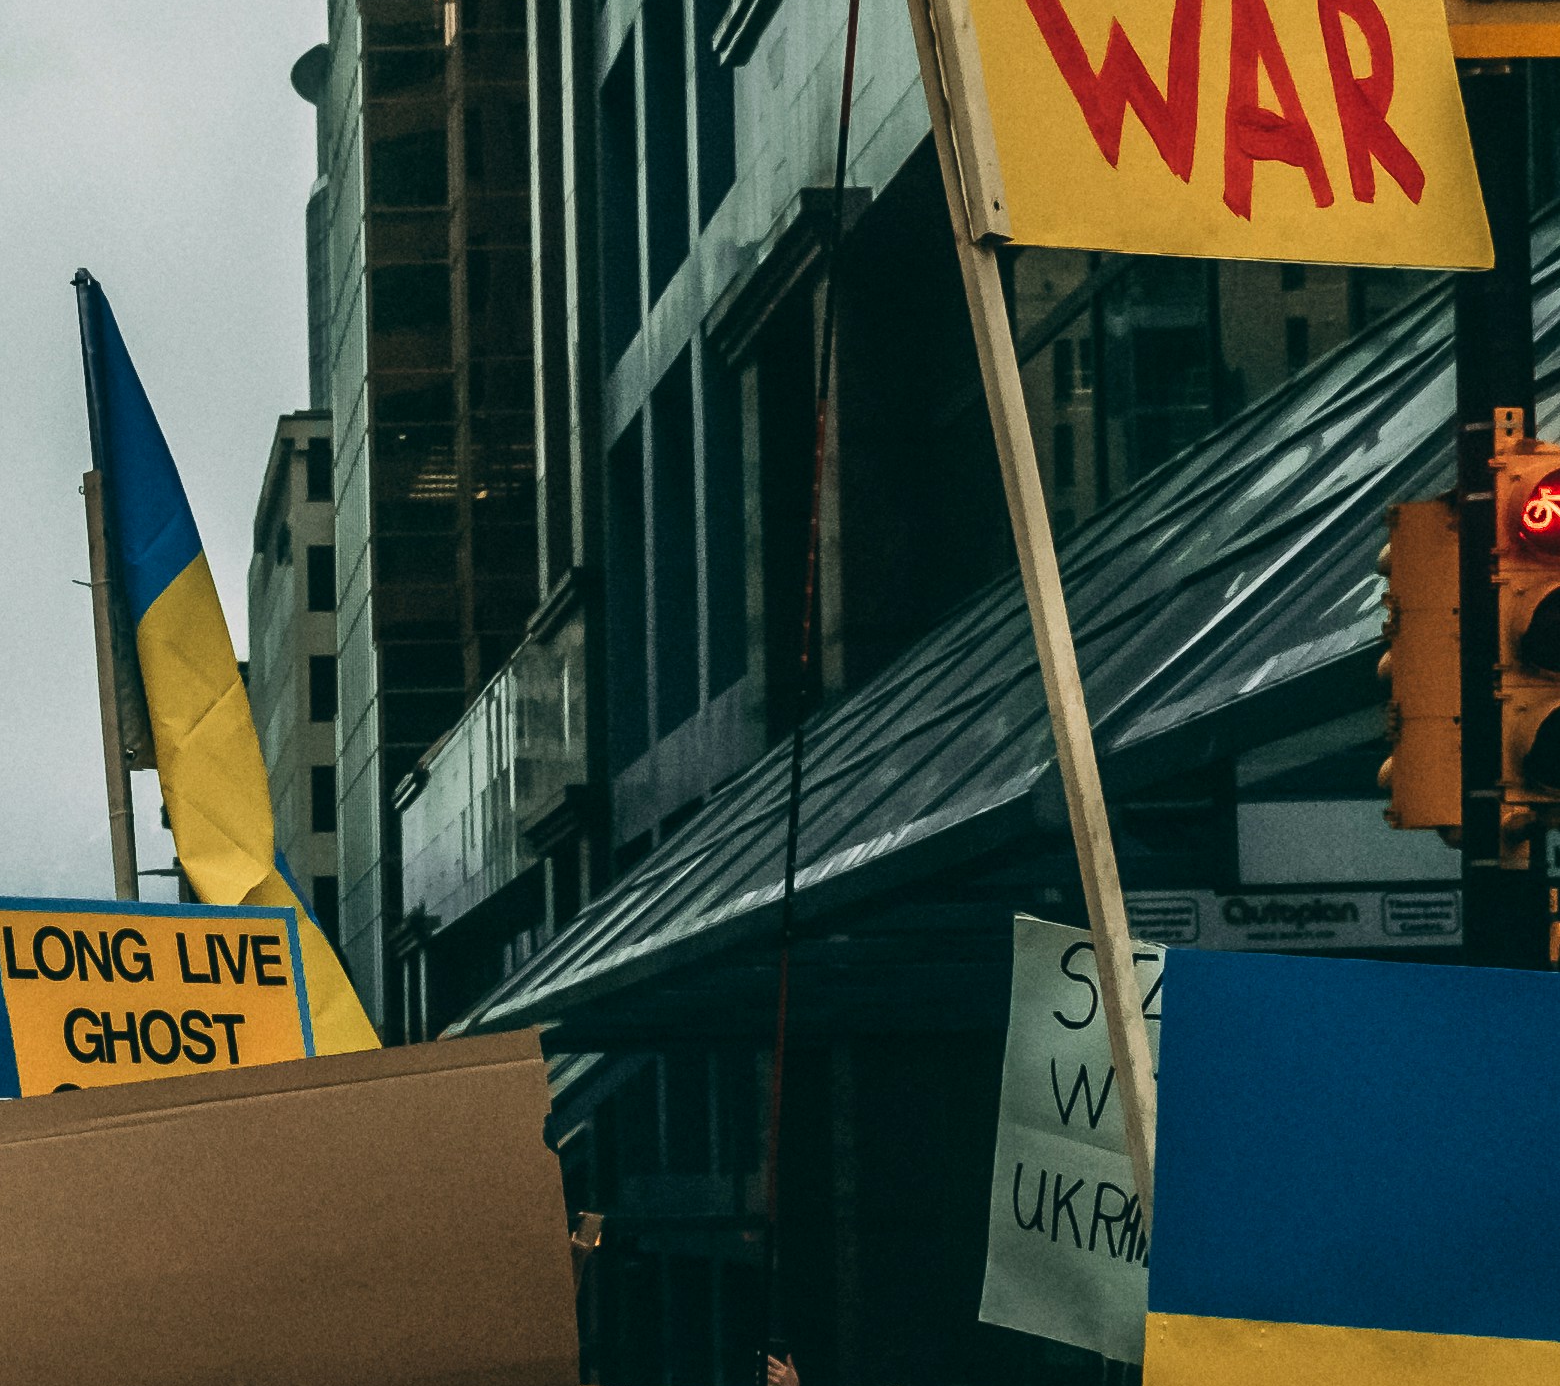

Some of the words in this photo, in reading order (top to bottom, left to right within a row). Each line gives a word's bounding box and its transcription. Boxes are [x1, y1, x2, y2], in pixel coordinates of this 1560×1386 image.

[2, 926, 154, 983] LONG
[176, 933, 287, 986] LIVE
[63, 1007, 245, 1065] GHOST
